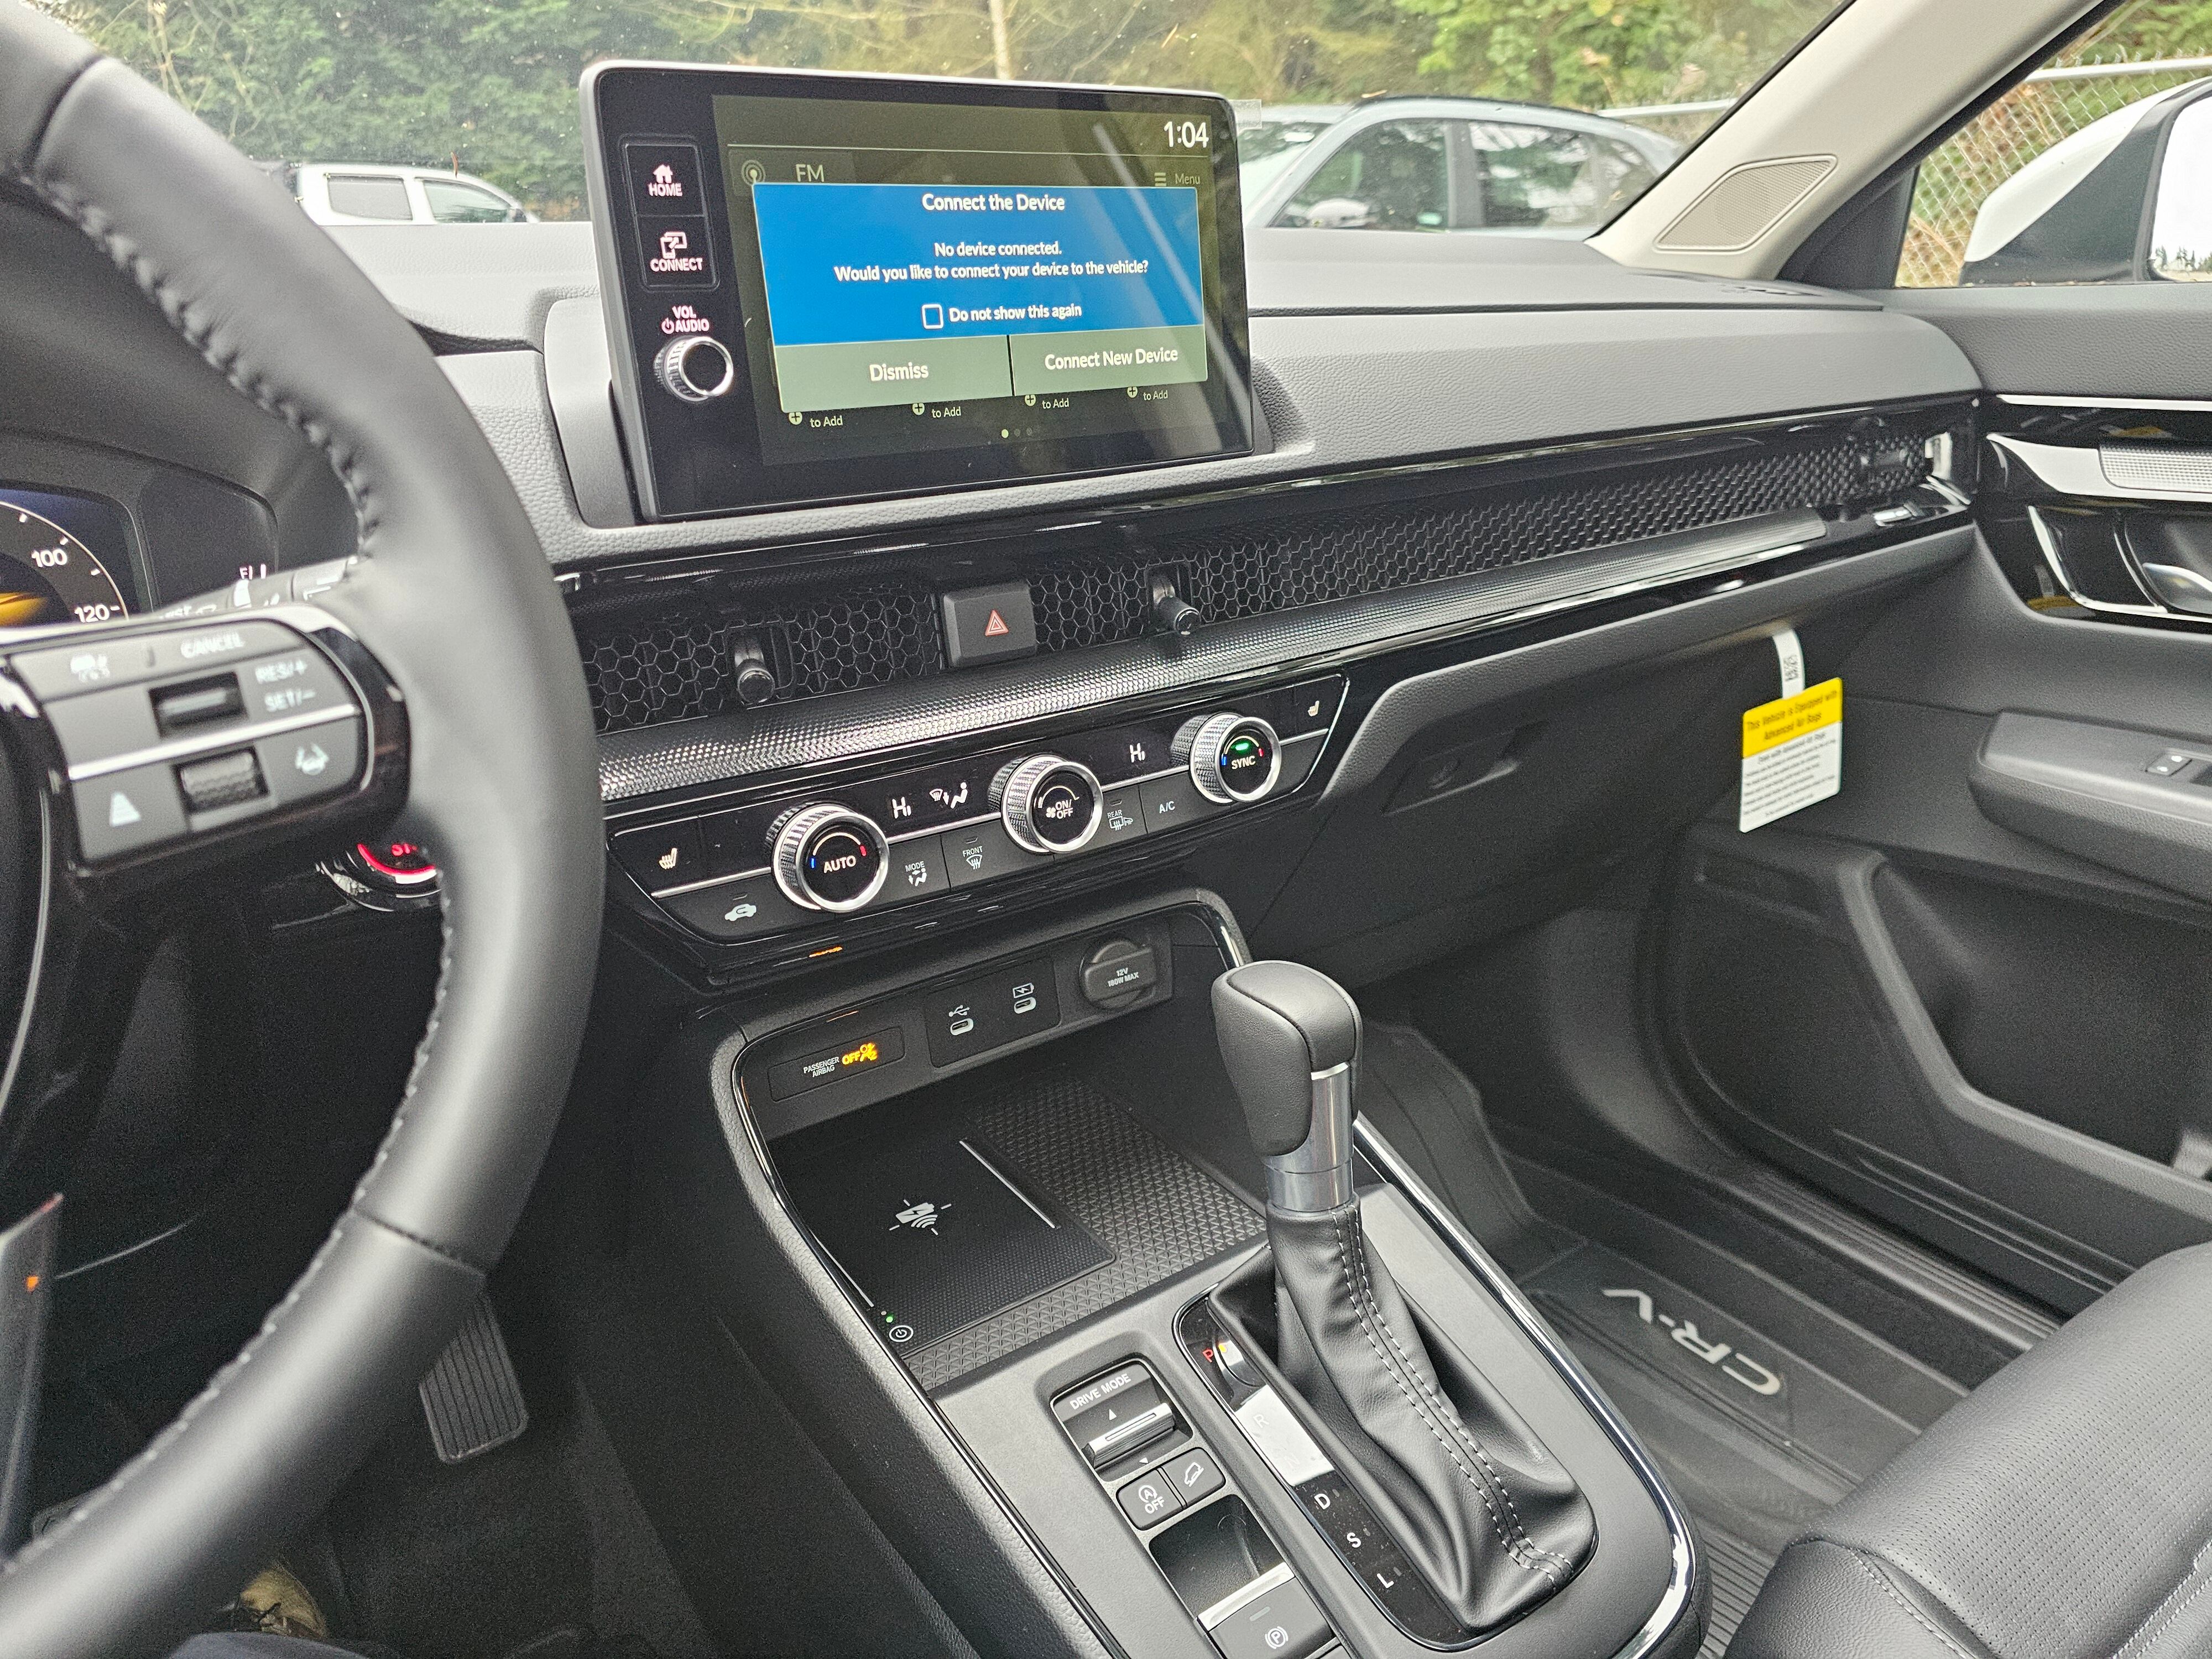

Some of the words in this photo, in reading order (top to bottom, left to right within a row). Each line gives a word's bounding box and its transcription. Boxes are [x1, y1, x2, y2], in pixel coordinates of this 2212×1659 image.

[1163, 121, 1209, 148] 1:04
[795, 164, 825, 182] FM
[1175, 173, 1201, 185] Menu
[649, 183, 682, 196] HOME
[922, 194, 985, 211] Connect
[989, 194, 1013, 211] the
[1016, 194, 1065, 211] Device
[934, 242, 954, 257] No
[957, 242, 995, 256] device
[998, 241, 1062, 255] connected.
[650, 258, 702, 272] CONNECT
[834, 265, 880, 281] Would
[882, 268, 907, 282] you
[909, 264, 932, 279] like
[934, 265, 948, 278] to
[951, 263, 1000, 278] connect
[1001, 265, 1029, 279] your
[1032, 262, 1068, 275] device
[1071, 262, 1083, 275] to
[1086, 261, 1104, 274] the
[1106, 260, 1149, 274] vehicle?
[672, 306, 696, 319] VOL
[949, 307, 968, 322] Do
[971, 306, 992, 321] not
[994, 306, 1025, 320] show
[1027, 305, 1050, 318] this
[1052, 303, 1082, 320] again
[675, 319, 709, 332] AUDIO
[1045, 353, 1100, 371] Connect
[1103, 351, 1132, 367] New
[1135, 347, 1178, 364] Device
[869, 363, 929, 382] Dismiss
[1143, 392, 1152, 400] to
[1154, 390, 1168, 399] Add
[1042, 400, 1052, 409] to
[1054, 398, 1070, 408] Add
[931, 409, 942, 418] to
[944, 407, 961, 417] Add
[810, 417, 821, 428] to
[823, 415, 843, 427] Add
[32, 548, 67, 567] 100
[75, 606, 109, 623] 120
[180, 632, 245, 658] CANCEL
[1231, 757, 1256, 770] SYNC
[1055, 799, 1072, 810] ON/
[1159, 800, 1176, 813] A/C
[1056, 807, 1073, 820] OFF
[1107, 809, 1123, 818] REAR
[962, 846, 983, 857] FRONT
[823, 855, 856, 873] AUTO
[905, 860, 925, 872] MODE
[1116, 967, 1128, 977] 12V
[1124, 972, 1139, 982] MAX
[804, 1057, 839, 1073] PASSENGER
[842, 1051, 860, 1065] OFF
[812, 1065, 835, 1077] AIRBAG
[1604, 1288, 1780, 1395] CR-V
[1202, 1349, 1214, 1363] P
[1069, 1386, 1101, 1411] DRIVE
[1100, 1373, 1131, 1396] MODE
[1253, 1413, 1269, 1428] R
[1144, 1498, 1165, 1515] OFF
[1314, 1493, 1331, 1510] D
[1346, 1532, 1361, 1548] S
[1376, 1573, 1394, 1589] L
